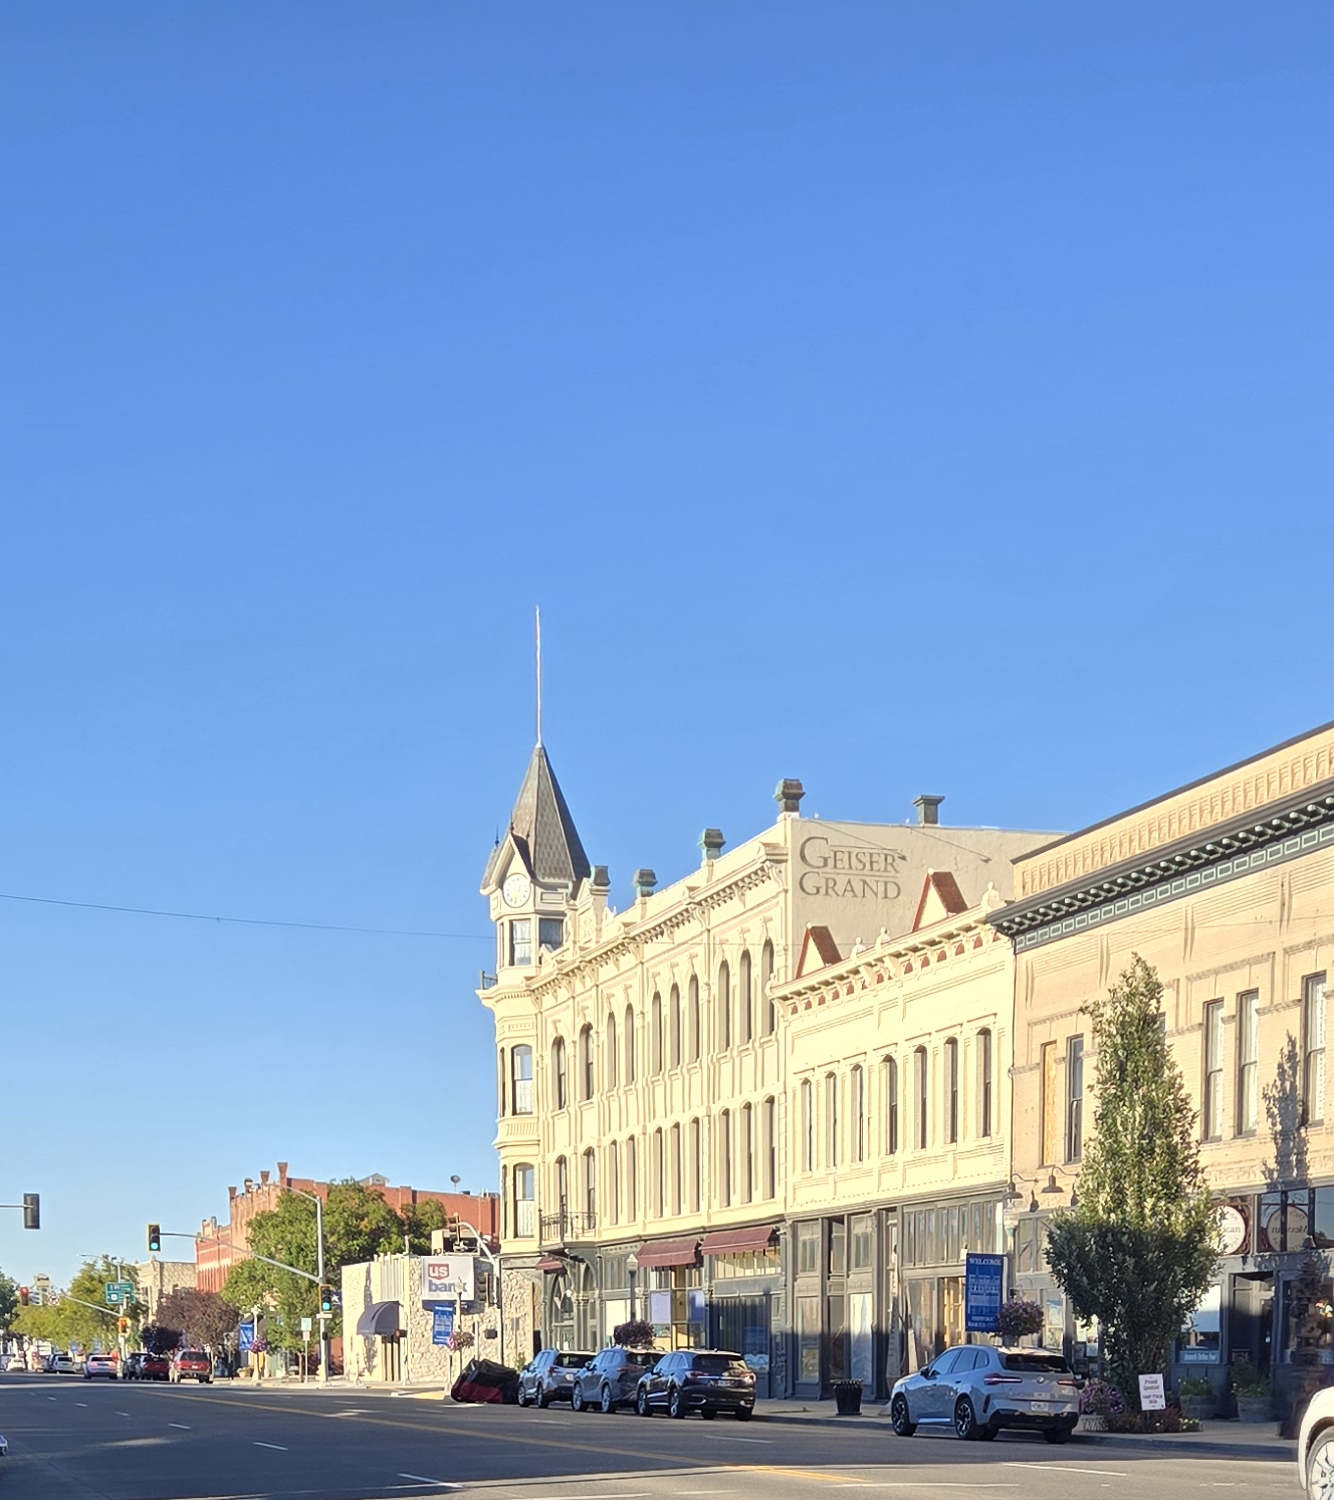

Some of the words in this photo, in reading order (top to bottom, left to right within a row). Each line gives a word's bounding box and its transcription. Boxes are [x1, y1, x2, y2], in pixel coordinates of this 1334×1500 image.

[799, 836, 900, 874] GEISER
[799, 871, 901, 900] GRAND
[429, 1265, 448, 1277] us
